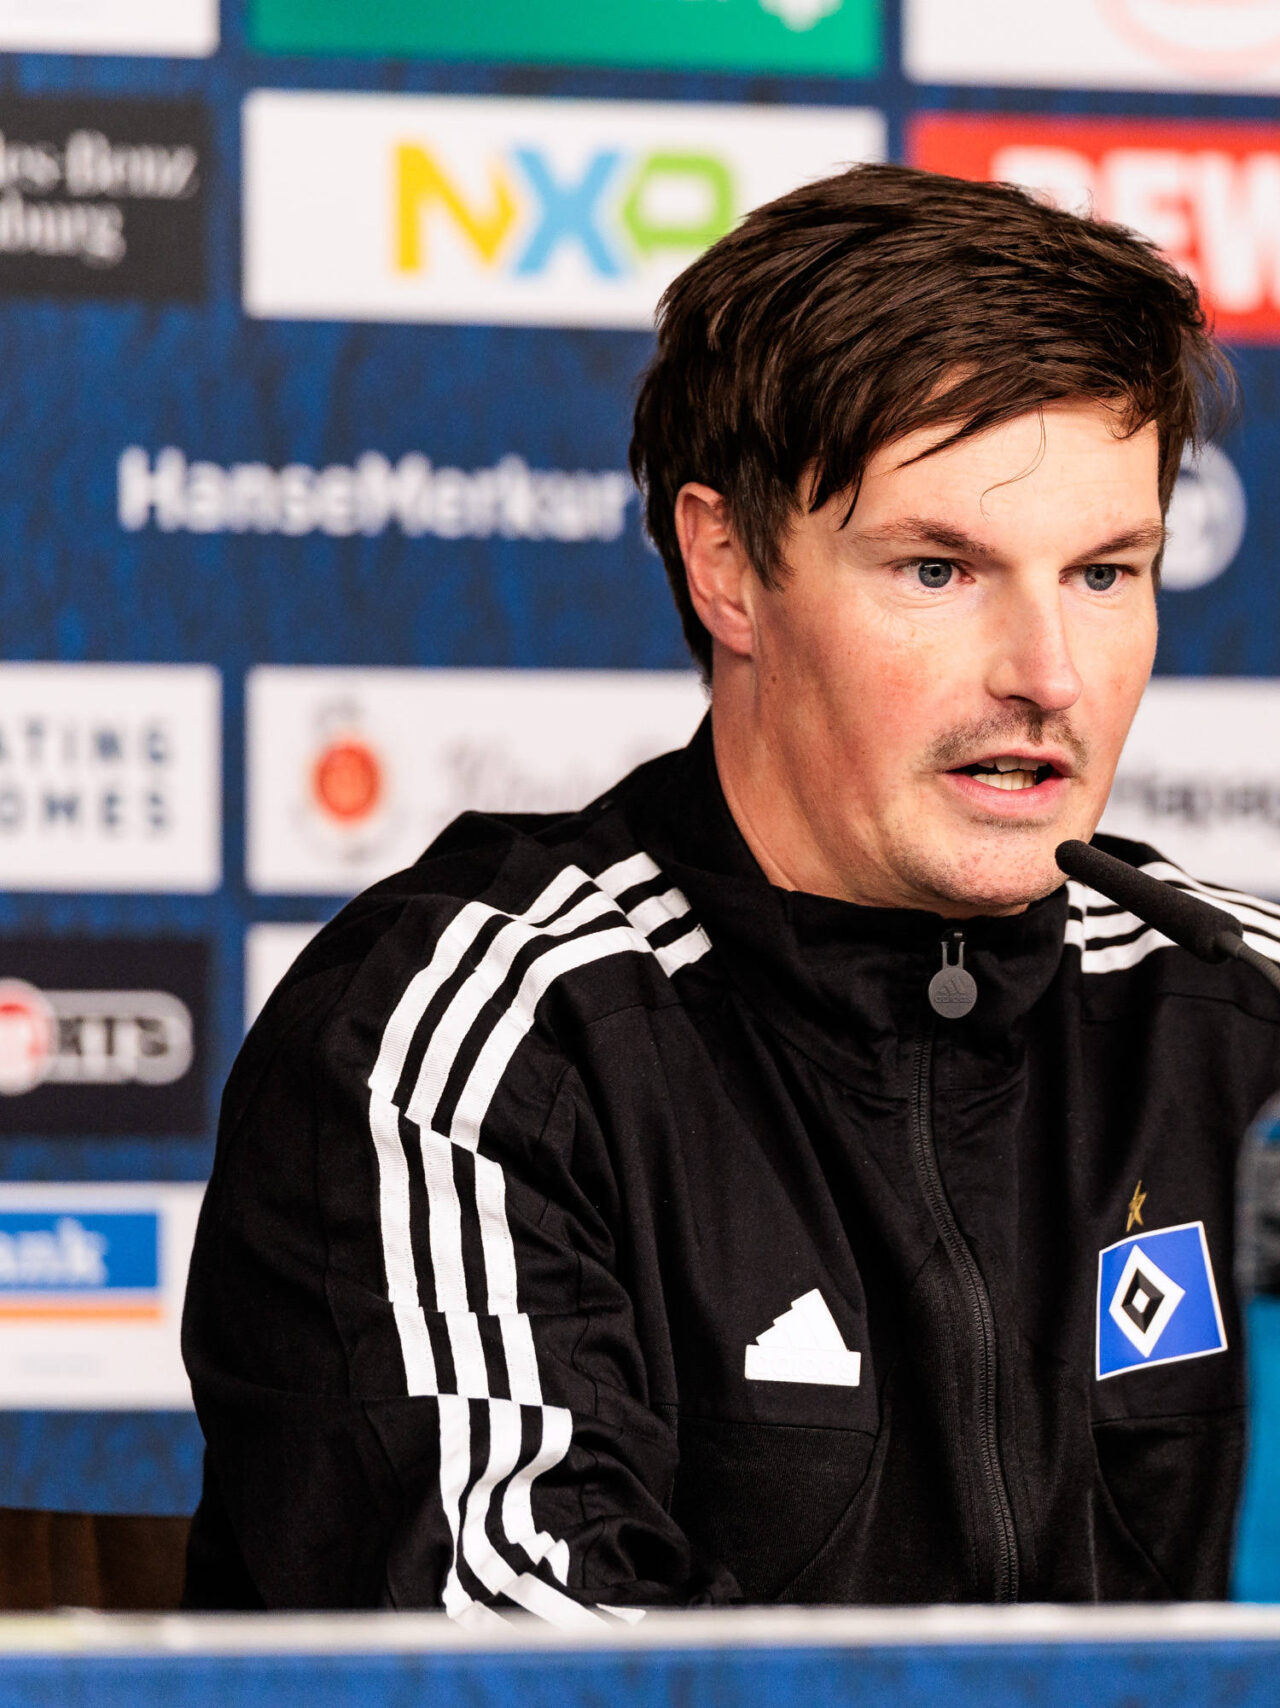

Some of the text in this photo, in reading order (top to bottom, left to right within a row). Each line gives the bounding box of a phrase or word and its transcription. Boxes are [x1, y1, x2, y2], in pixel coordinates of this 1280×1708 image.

[0, 130, 197, 198] es-Benz
[393, 142, 736, 278] NXP
[118, 446, 628, 540] HanseMerkur
